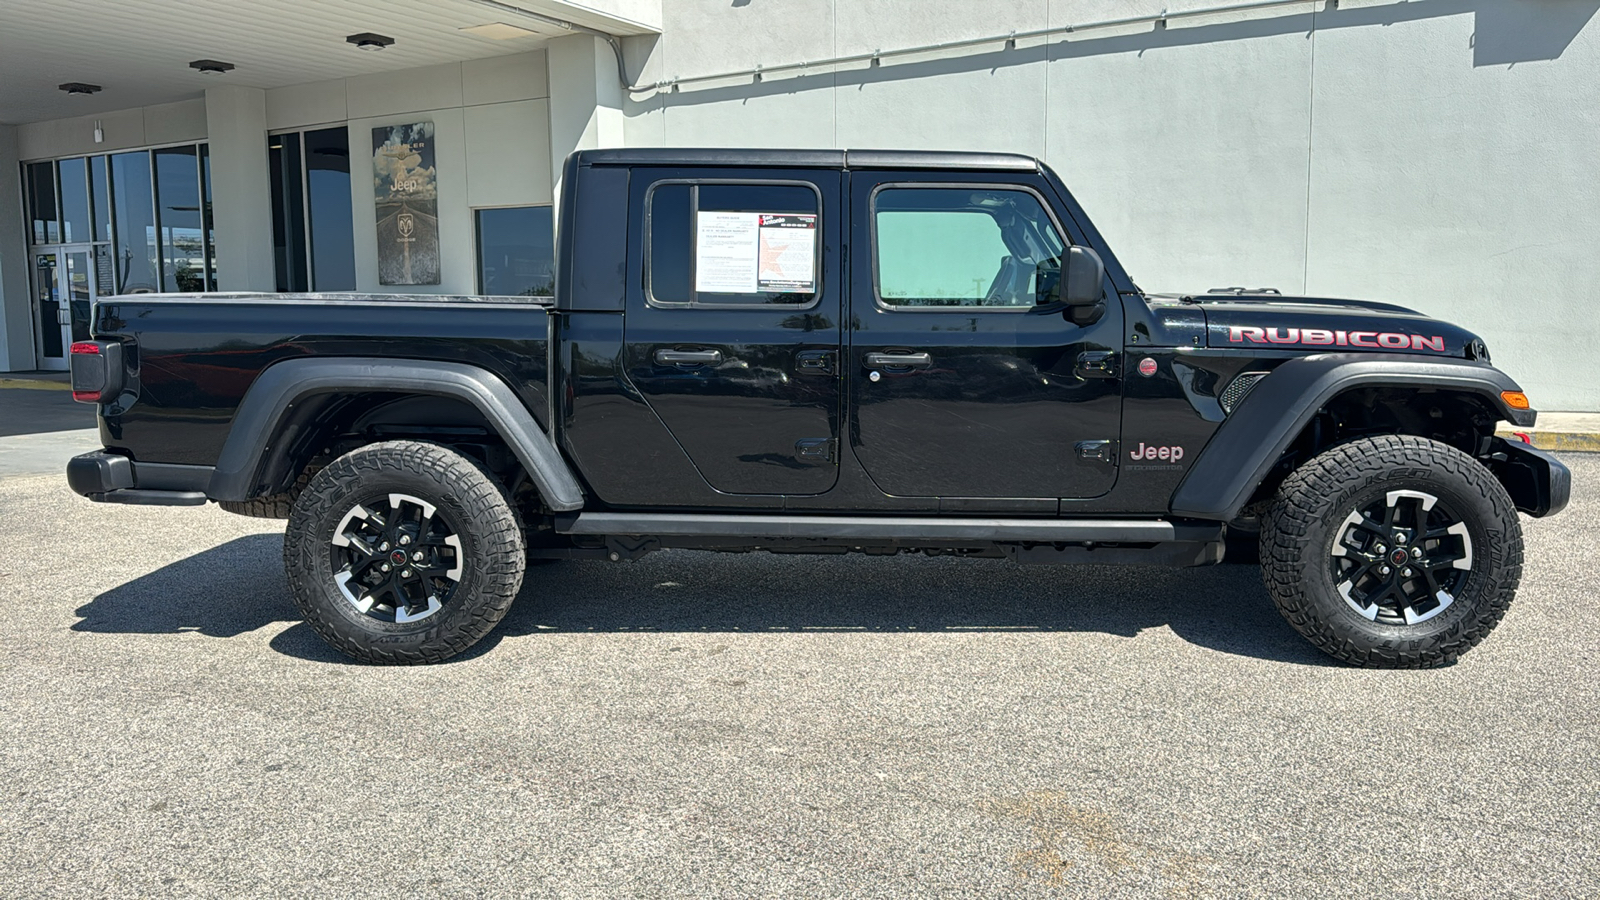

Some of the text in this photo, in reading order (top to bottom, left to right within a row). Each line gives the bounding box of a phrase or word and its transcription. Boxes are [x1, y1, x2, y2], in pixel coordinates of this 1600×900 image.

[382, 142, 425, 151] SLER
[390, 178, 417, 193] Jeep
[1229, 326, 1445, 351] RUBICON
[1130, 442, 1184, 463] Jeep
[1321, 467, 1433, 528] FALKEN
[302, 476, 363, 576] FALKEN
[1430, 527, 1503, 648] WILDPEAK
